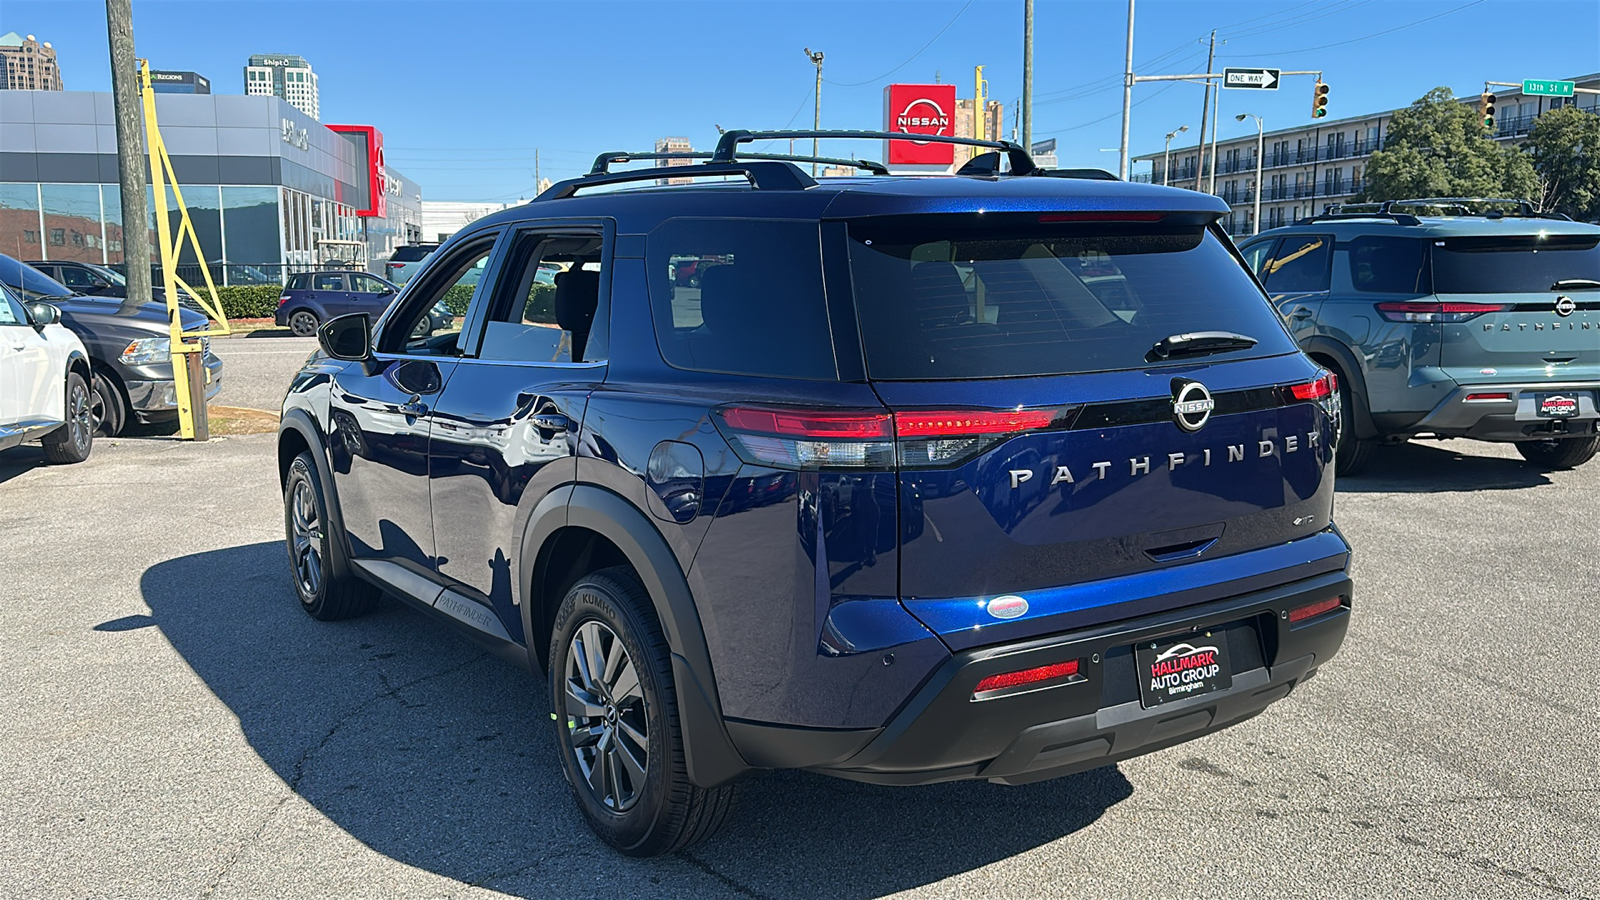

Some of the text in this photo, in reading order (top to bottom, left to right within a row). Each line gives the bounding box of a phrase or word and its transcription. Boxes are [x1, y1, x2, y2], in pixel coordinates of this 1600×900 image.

[263, 59, 283, 67] Shipt
[1230, 74, 1263, 83] ONE WAY
[1529, 83, 1543, 91] 13th
[1549, 84, 1557, 92] St
[898, 117, 948, 126] NISSAN
[1174, 401, 1214, 413] NISSAN
[1009, 431, 1319, 489] PATHFINDER
[439, 594, 492, 628] PATHFINDER
[582, 593, 616, 619] KUMHO
[1151, 652, 1215, 677] HALLMARK
[1150, 664, 1219, 691] AUTO GROUP
[1168, 681, 1204, 694] Birmingham
